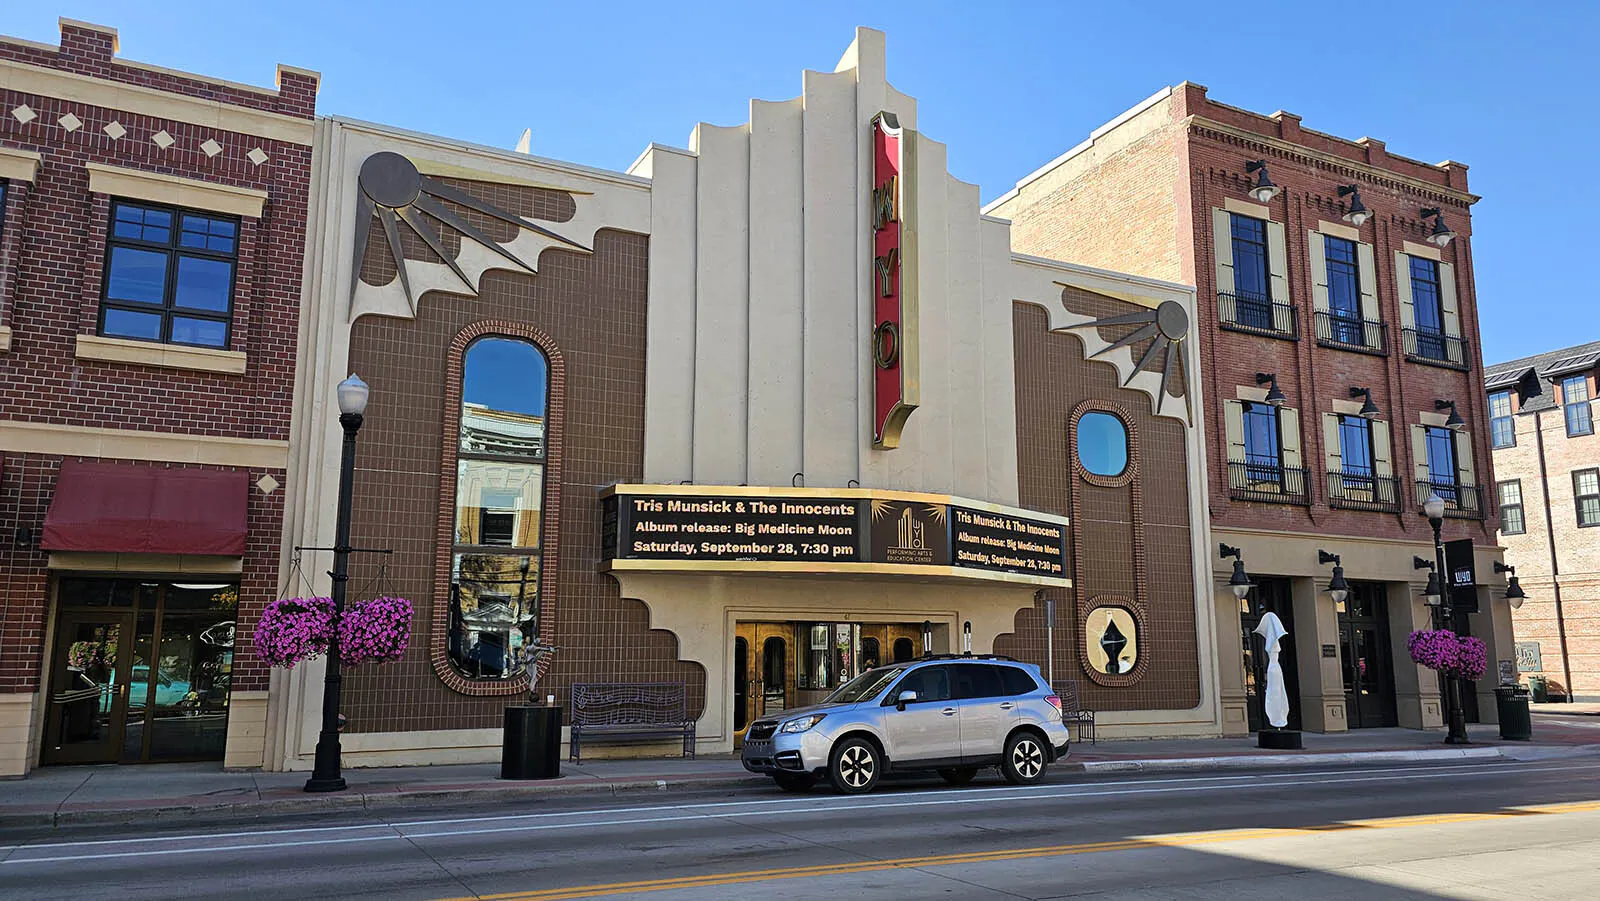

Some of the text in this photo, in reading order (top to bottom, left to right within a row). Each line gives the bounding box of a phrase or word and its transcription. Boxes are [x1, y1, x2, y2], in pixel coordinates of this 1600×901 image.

[873, 175, 900, 369] WYO
[634, 500, 855, 515] Tris Munsick & The Innocents
[635, 521, 853, 536] Album release: Big Medicine Moon
[913, 518, 921, 548] WYO
[956, 511, 1059, 538] Tris Munsick & The Innocents
[634, 541, 853, 556] Saturday, September 28, 7:30 pm
[958, 532, 1059, 555] Album release: Big Medicine Moon
[958, 550, 1061, 573] Saturday, September 28, 7:30 pm
